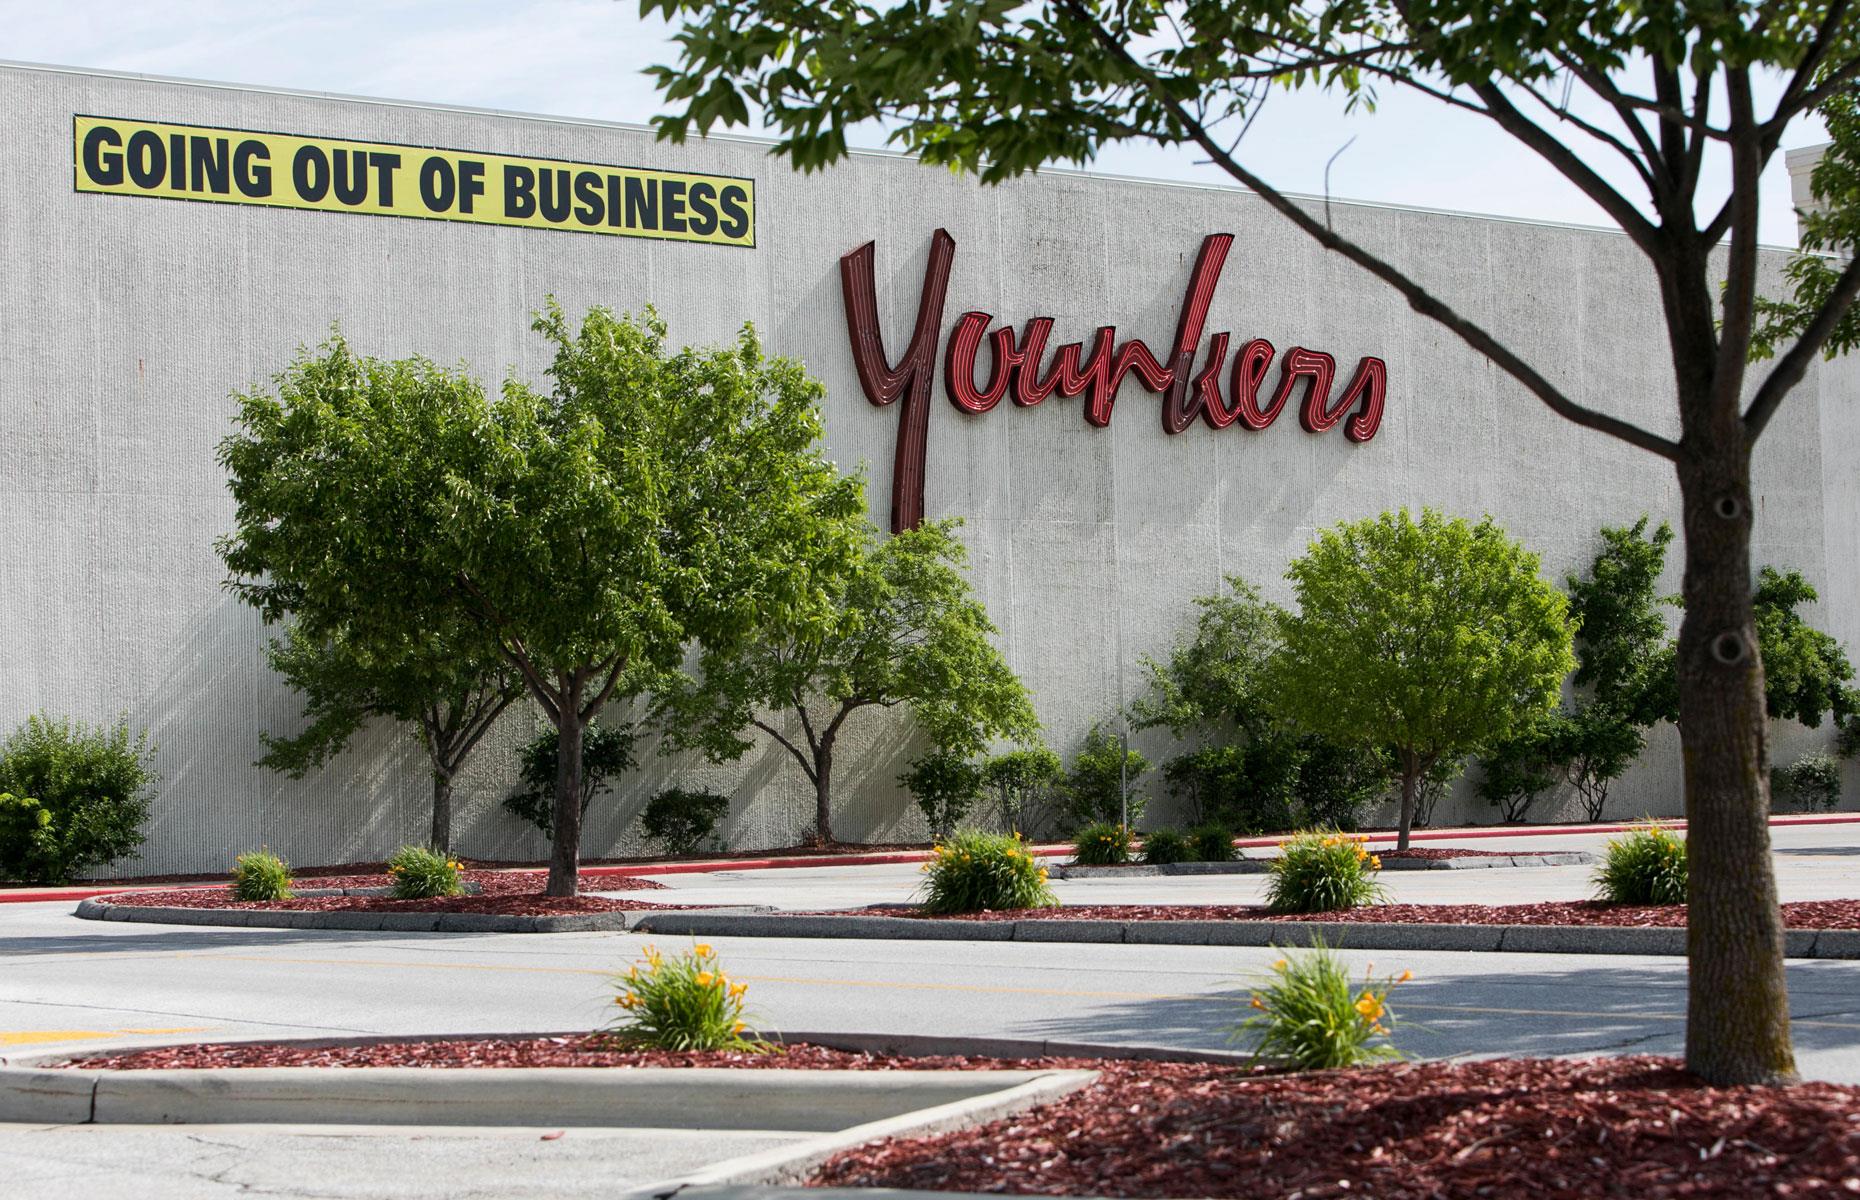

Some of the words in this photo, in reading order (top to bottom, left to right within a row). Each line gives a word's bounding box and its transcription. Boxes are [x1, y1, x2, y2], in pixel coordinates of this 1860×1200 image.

[83, 126, 272, 198] GOING
[292, 145, 401, 207] OUT
[419, 156, 485, 213] OF
[503, 164, 749, 238] BUSINESS
[840, 227, 1387, 533] Younkers
